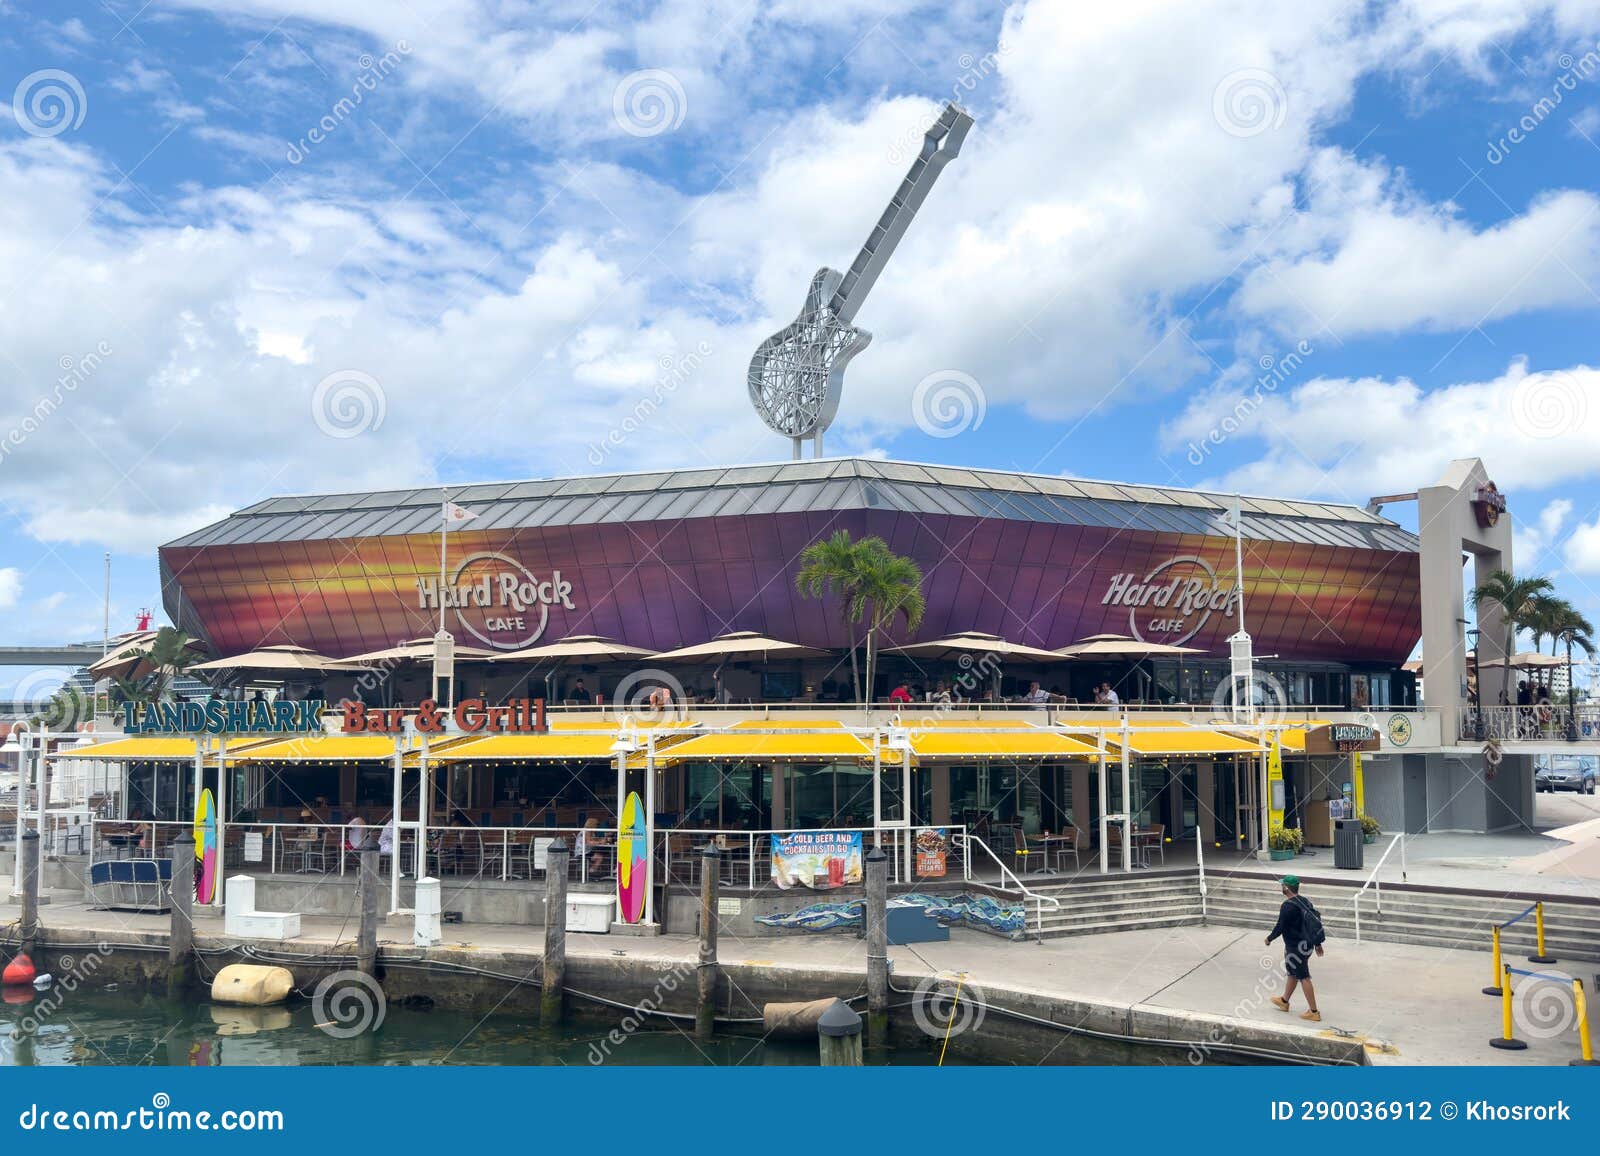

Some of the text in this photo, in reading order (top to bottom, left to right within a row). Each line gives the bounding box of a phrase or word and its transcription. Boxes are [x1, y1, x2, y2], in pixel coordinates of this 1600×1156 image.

[417, 570, 576, 612] Hard Rock
[1101, 573, 1243, 617] Hard Rock
[486, 616, 527, 631] CAFE
[1149, 618, 1185, 633] CAFE
[122, 698, 551, 734] LANDSHARK Bar & Grill
[794, 834, 813, 843] COLD
[815, 833, 834, 844] BEER
[836, 833, 852, 843] AND
[784, 844, 848, 855] COCKTAILS TO GO
